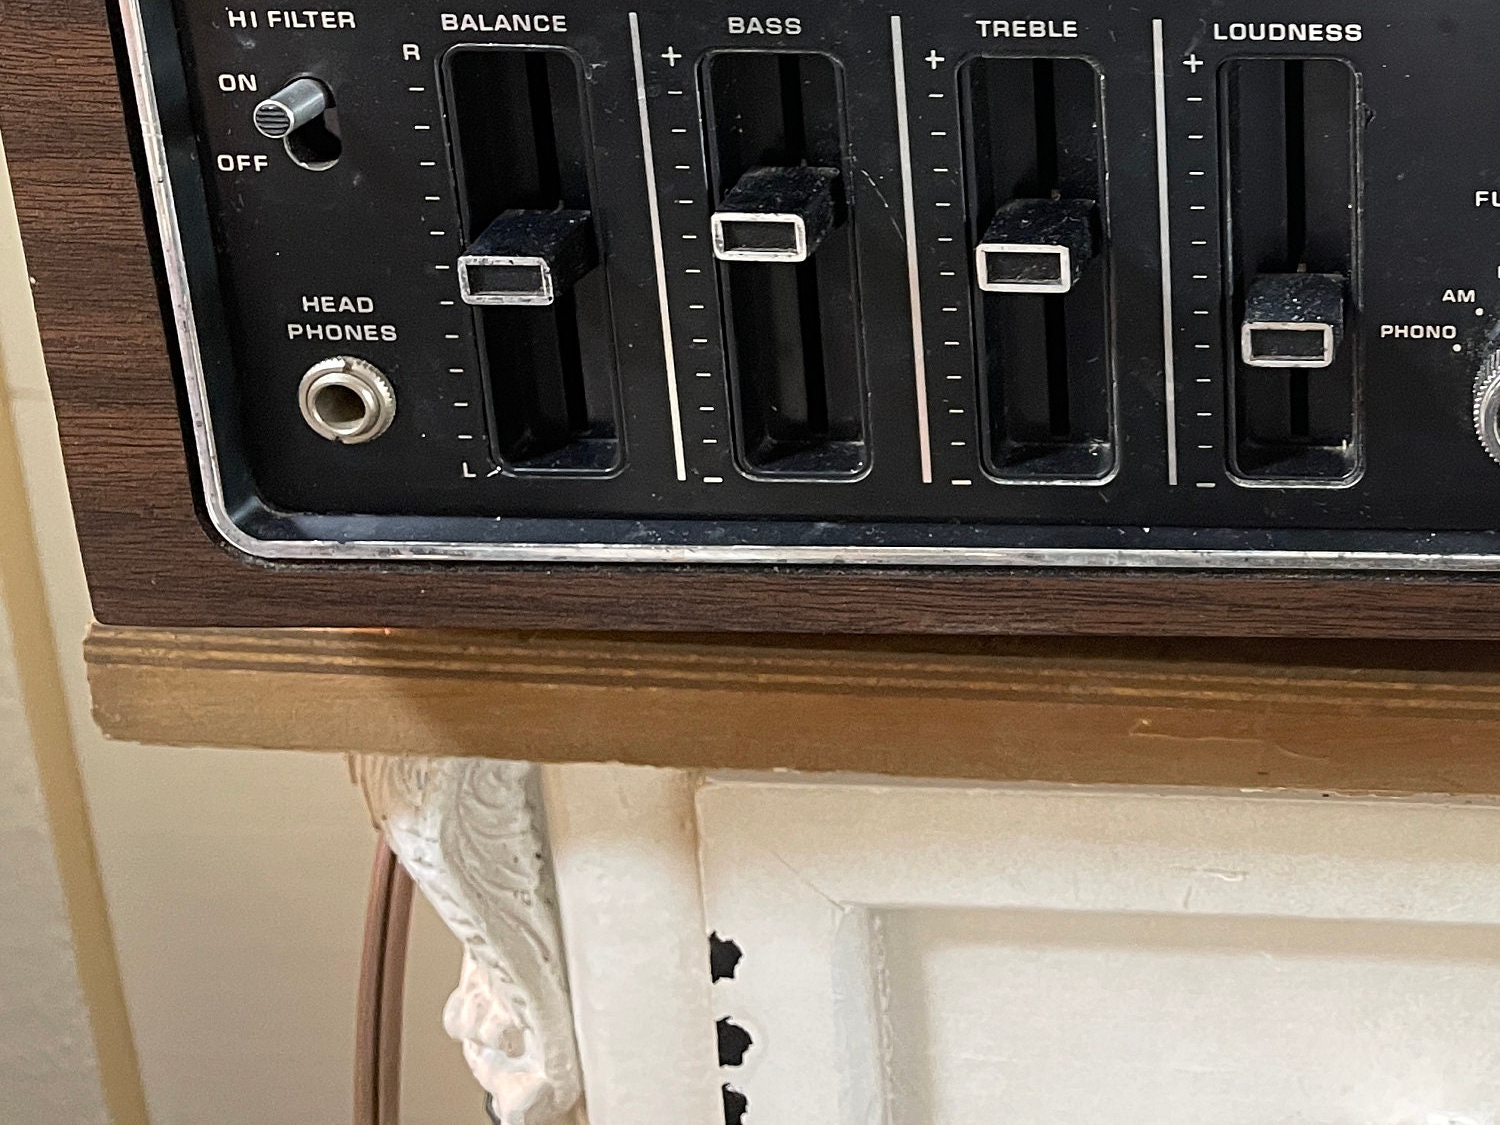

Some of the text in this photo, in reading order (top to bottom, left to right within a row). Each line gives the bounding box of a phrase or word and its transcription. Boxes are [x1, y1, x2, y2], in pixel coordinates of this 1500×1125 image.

[227, 9, 356, 29] HI FILTER
[440, 13, 568, 32] BALANCE
[727, 16, 802, 35] BASS
[975, 20, 1078, 38] TREBLE
[1213, 23, 1362, 42] LOUDNESS
[402, 44, 421, 61] R
[218, 73, 258, 92] ON
[217, 154, 268, 172] OFF
[302, 295, 374, 313] HEAD
[1442, 289, 1476, 303] AM
[287, 323, 397, 342] PHONES
[1380, 324, 1457, 339] PHONO
[462, 462, 477, 478] L
